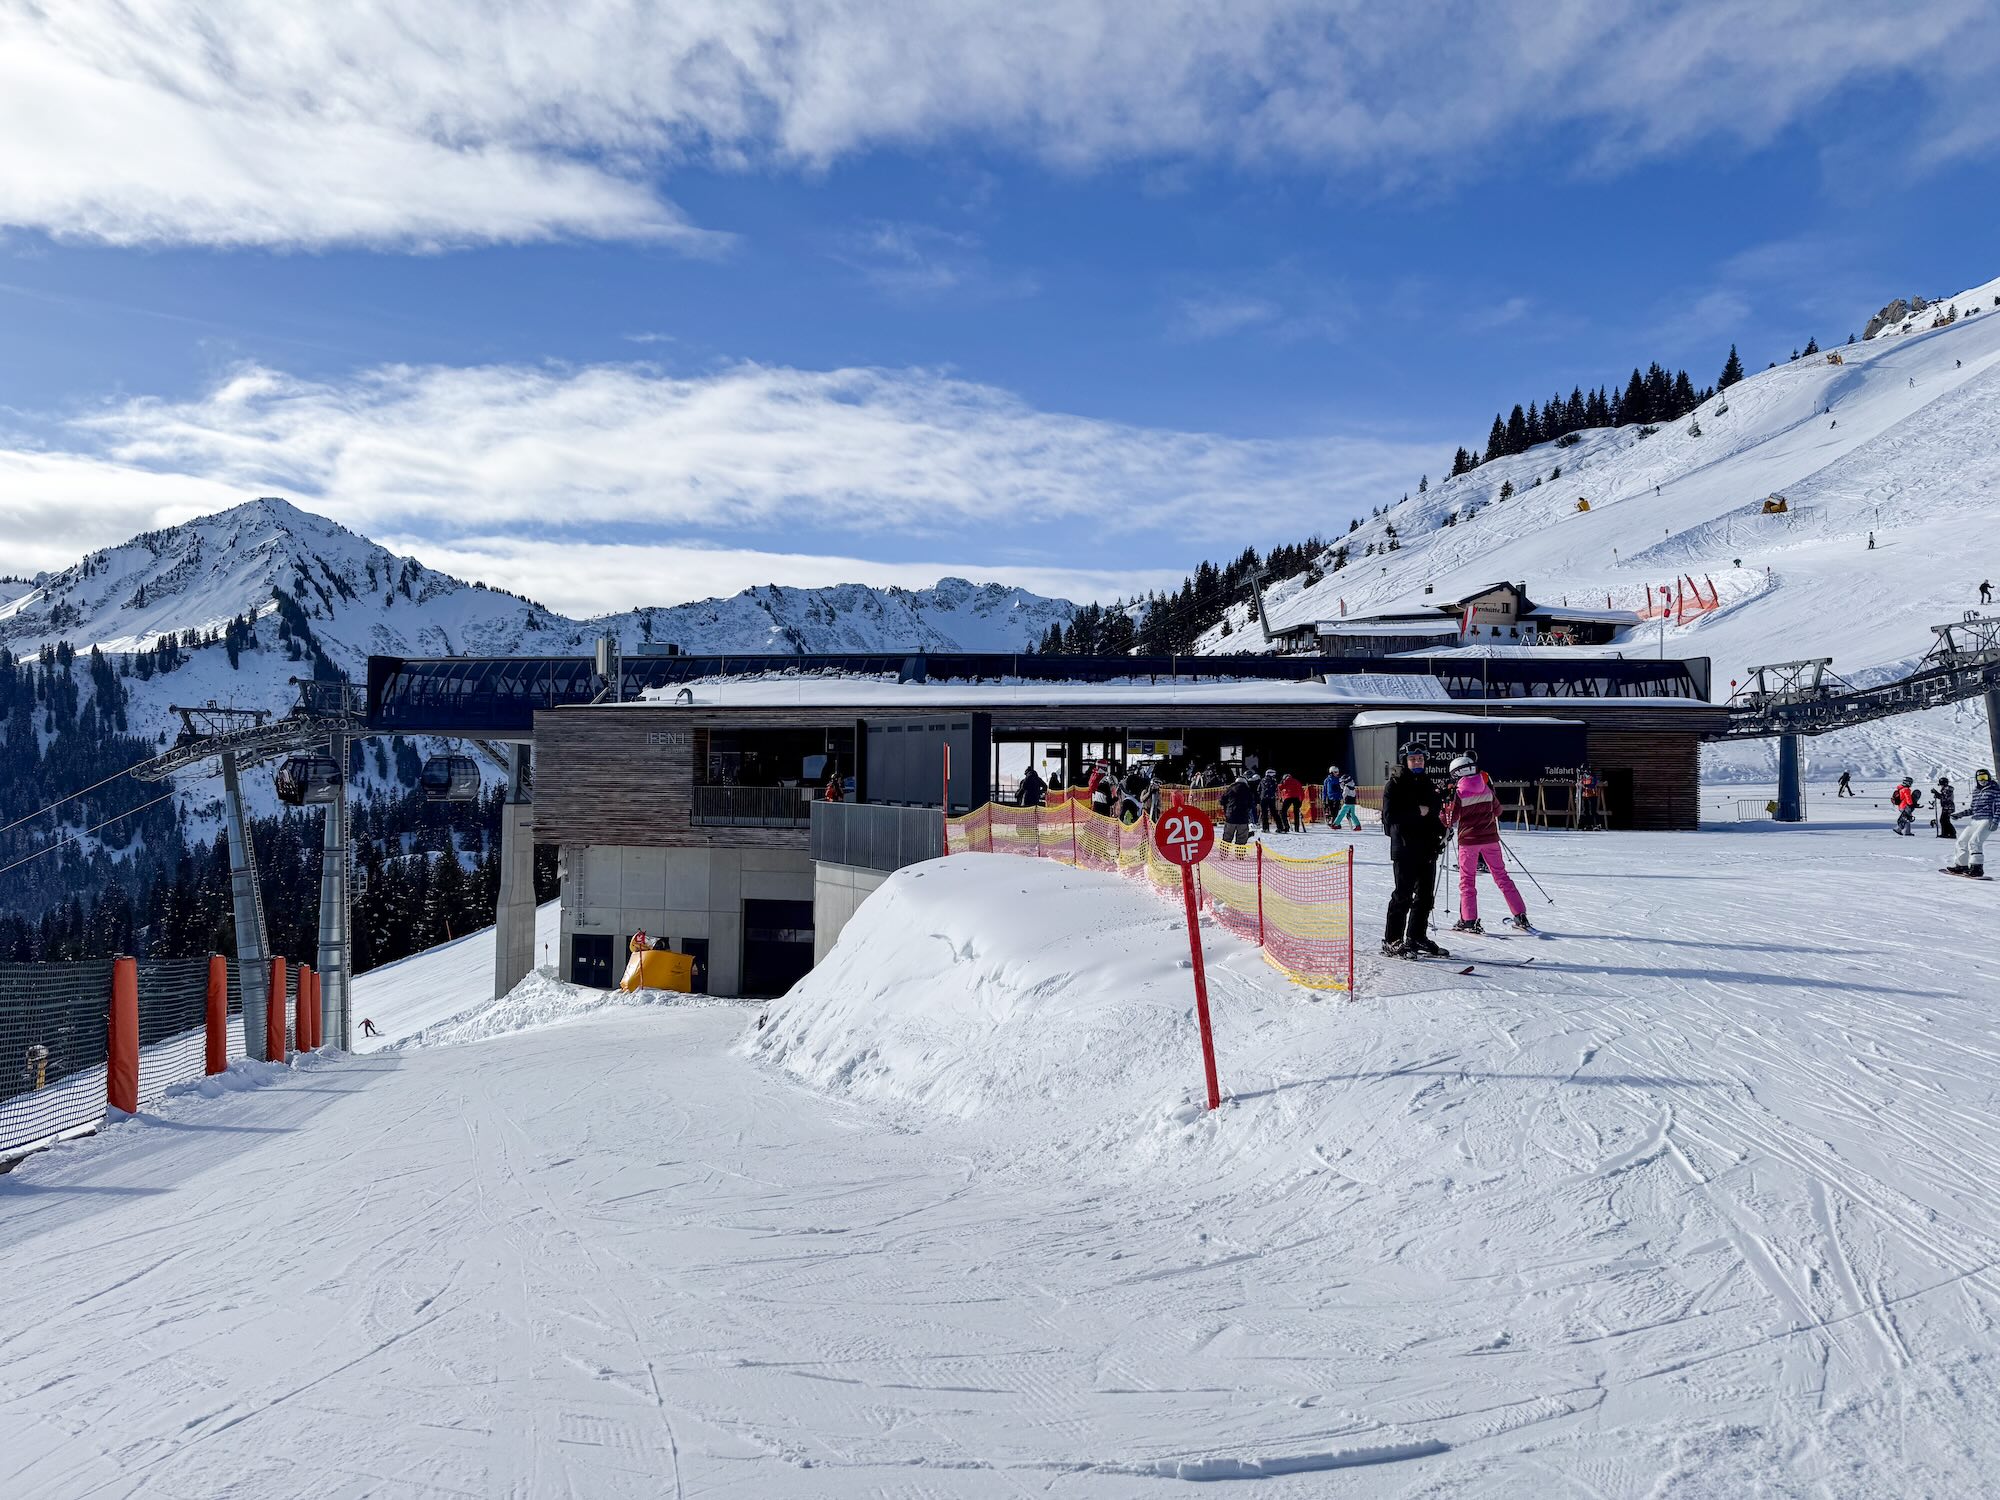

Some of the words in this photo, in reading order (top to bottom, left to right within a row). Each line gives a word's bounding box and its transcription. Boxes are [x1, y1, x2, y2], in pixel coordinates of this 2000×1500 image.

[646, 732, 677, 744] IFEN
[1410, 731, 1457, 749] IFEN
[1465, 732, 1475, 749] II
[1544, 766, 1575, 775] Talfahrt
[1164, 815, 1205, 845] 2b
[1180, 842, 1199, 862] IF
